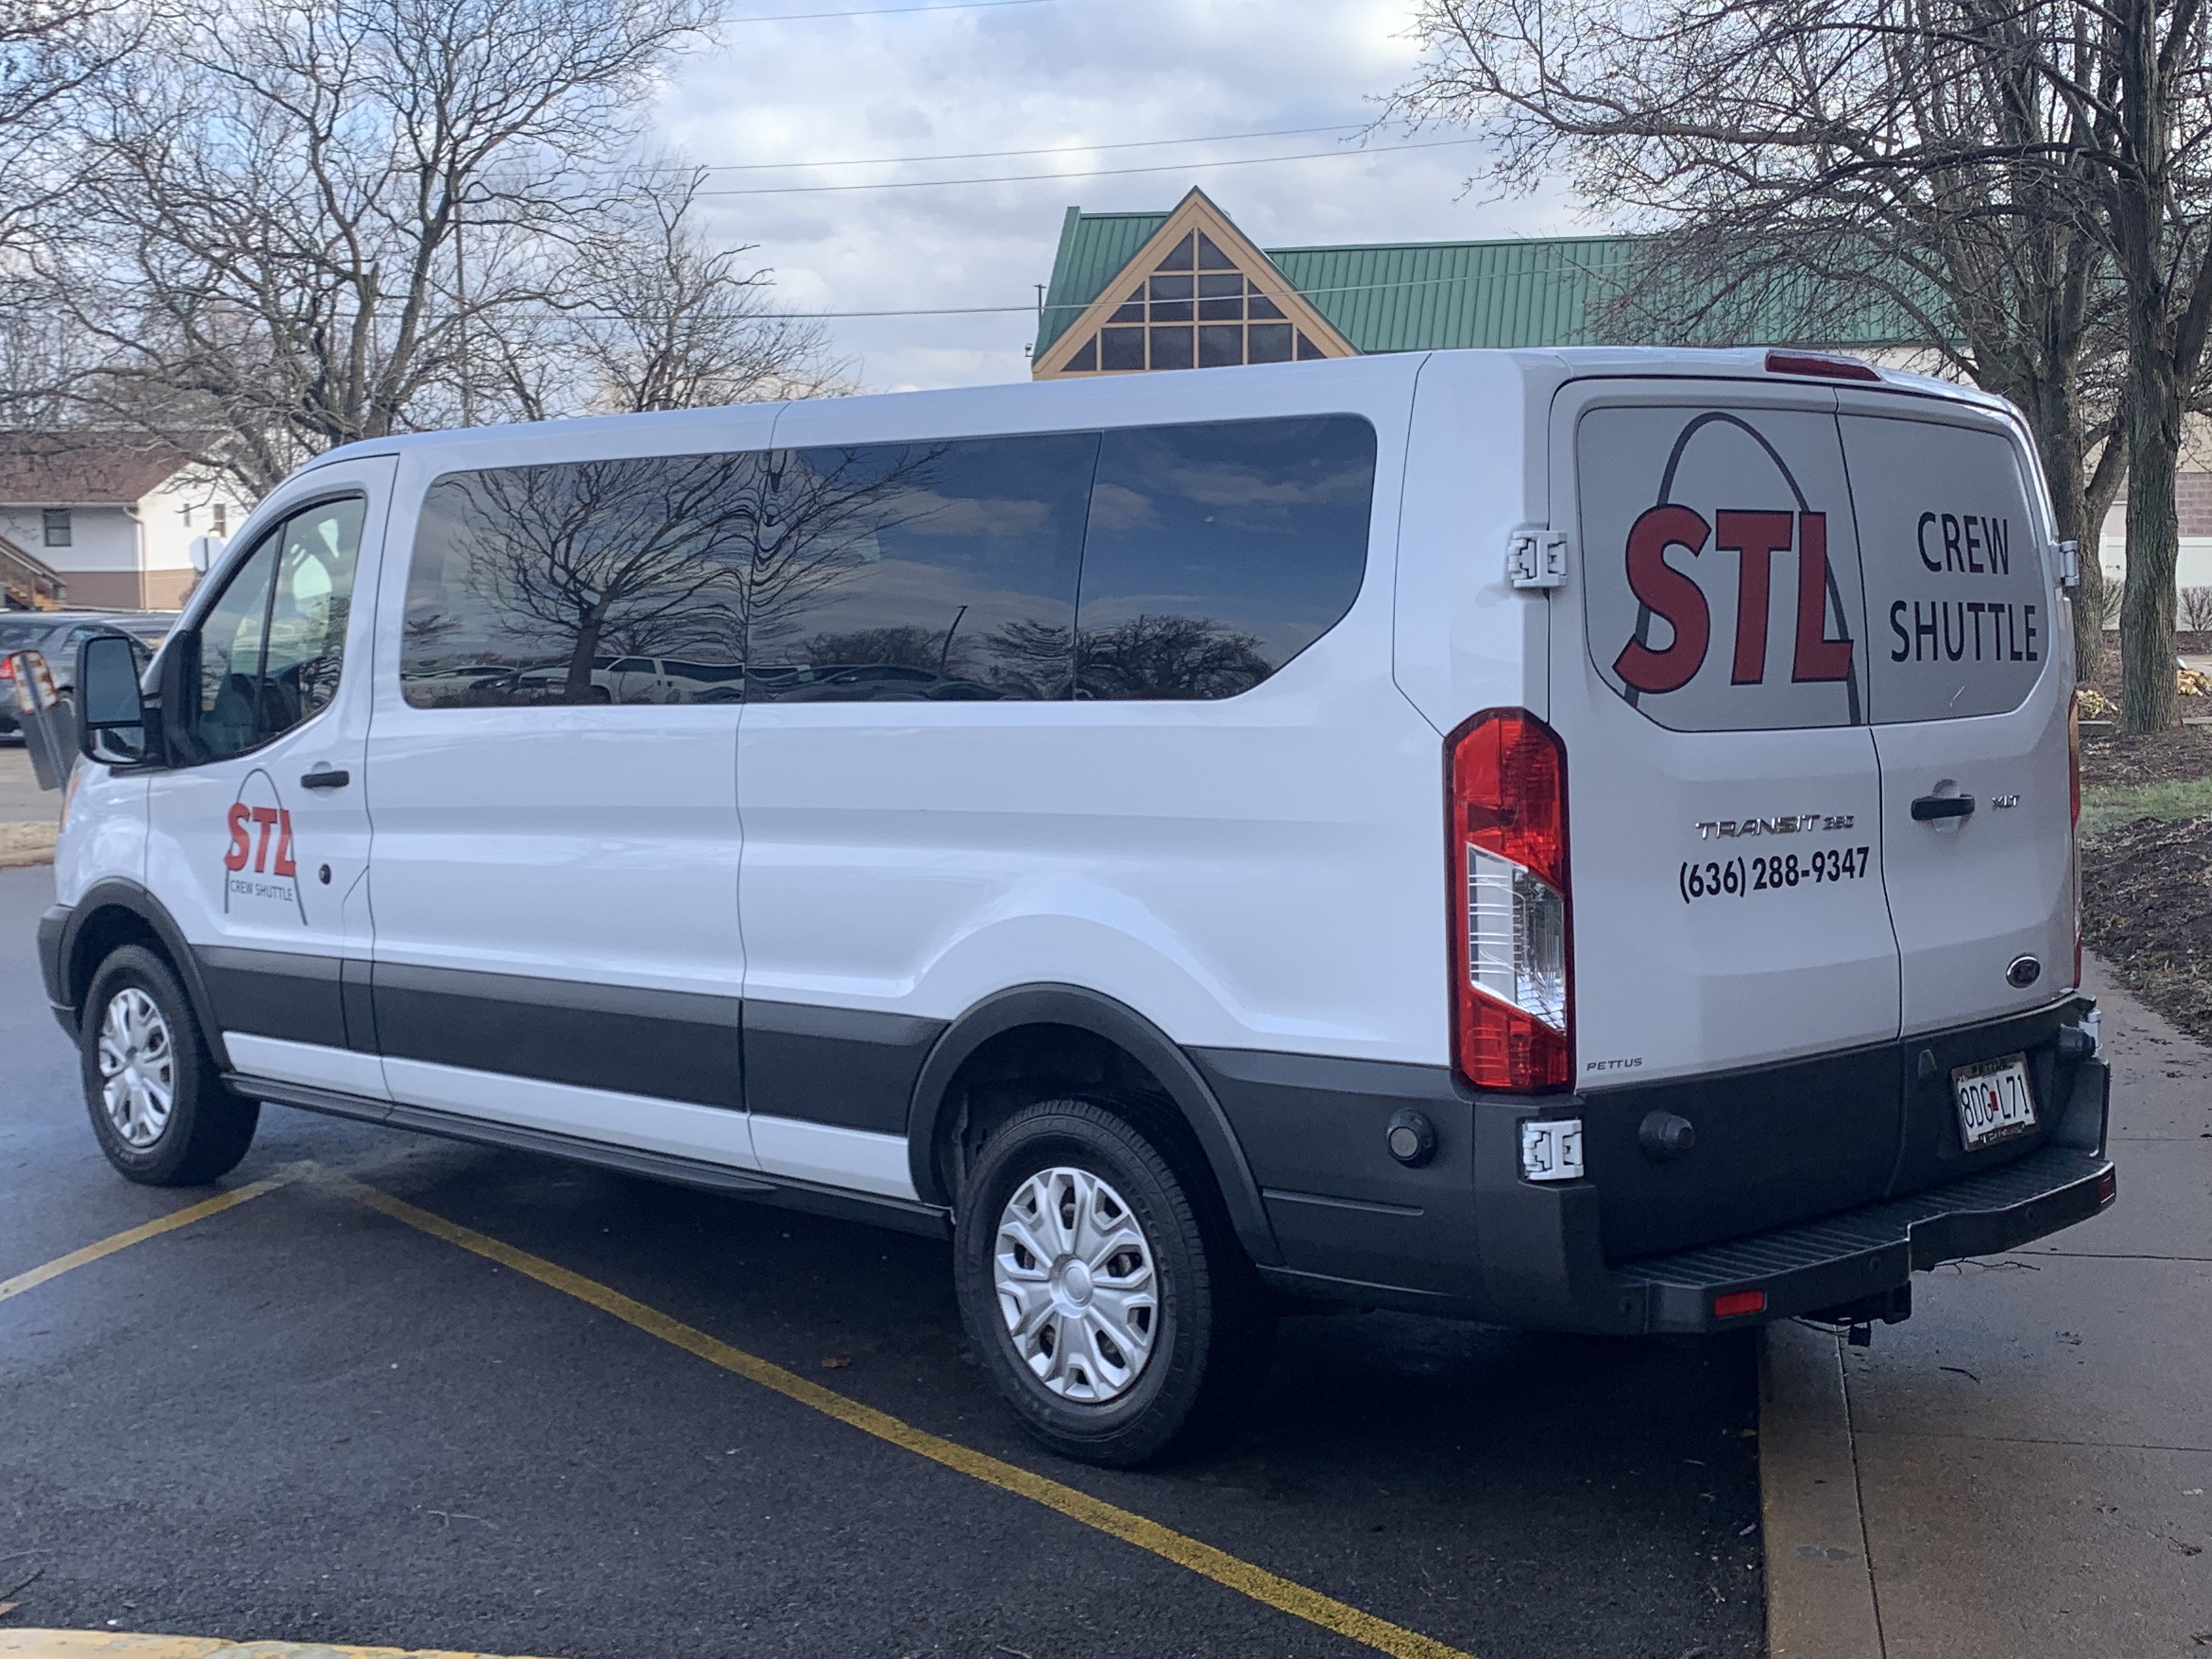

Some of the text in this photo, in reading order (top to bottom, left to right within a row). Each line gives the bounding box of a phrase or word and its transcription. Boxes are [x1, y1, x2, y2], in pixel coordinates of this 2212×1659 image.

[1917, 511, 2010, 575] CREW
[1612, 503, 1854, 693] STL
[1890, 600, 2038, 662] SHUTTLE
[1695, 814, 1820, 840] TRANSIT
[1992, 795, 2021, 810] XLT
[223, 802, 296, 878] STL
[230, 879, 294, 902] CREW SHUTTLE
[1680, 847, 1870, 904] (636) 288-9347
[1586, 1057, 1643, 1071] PETTUS
